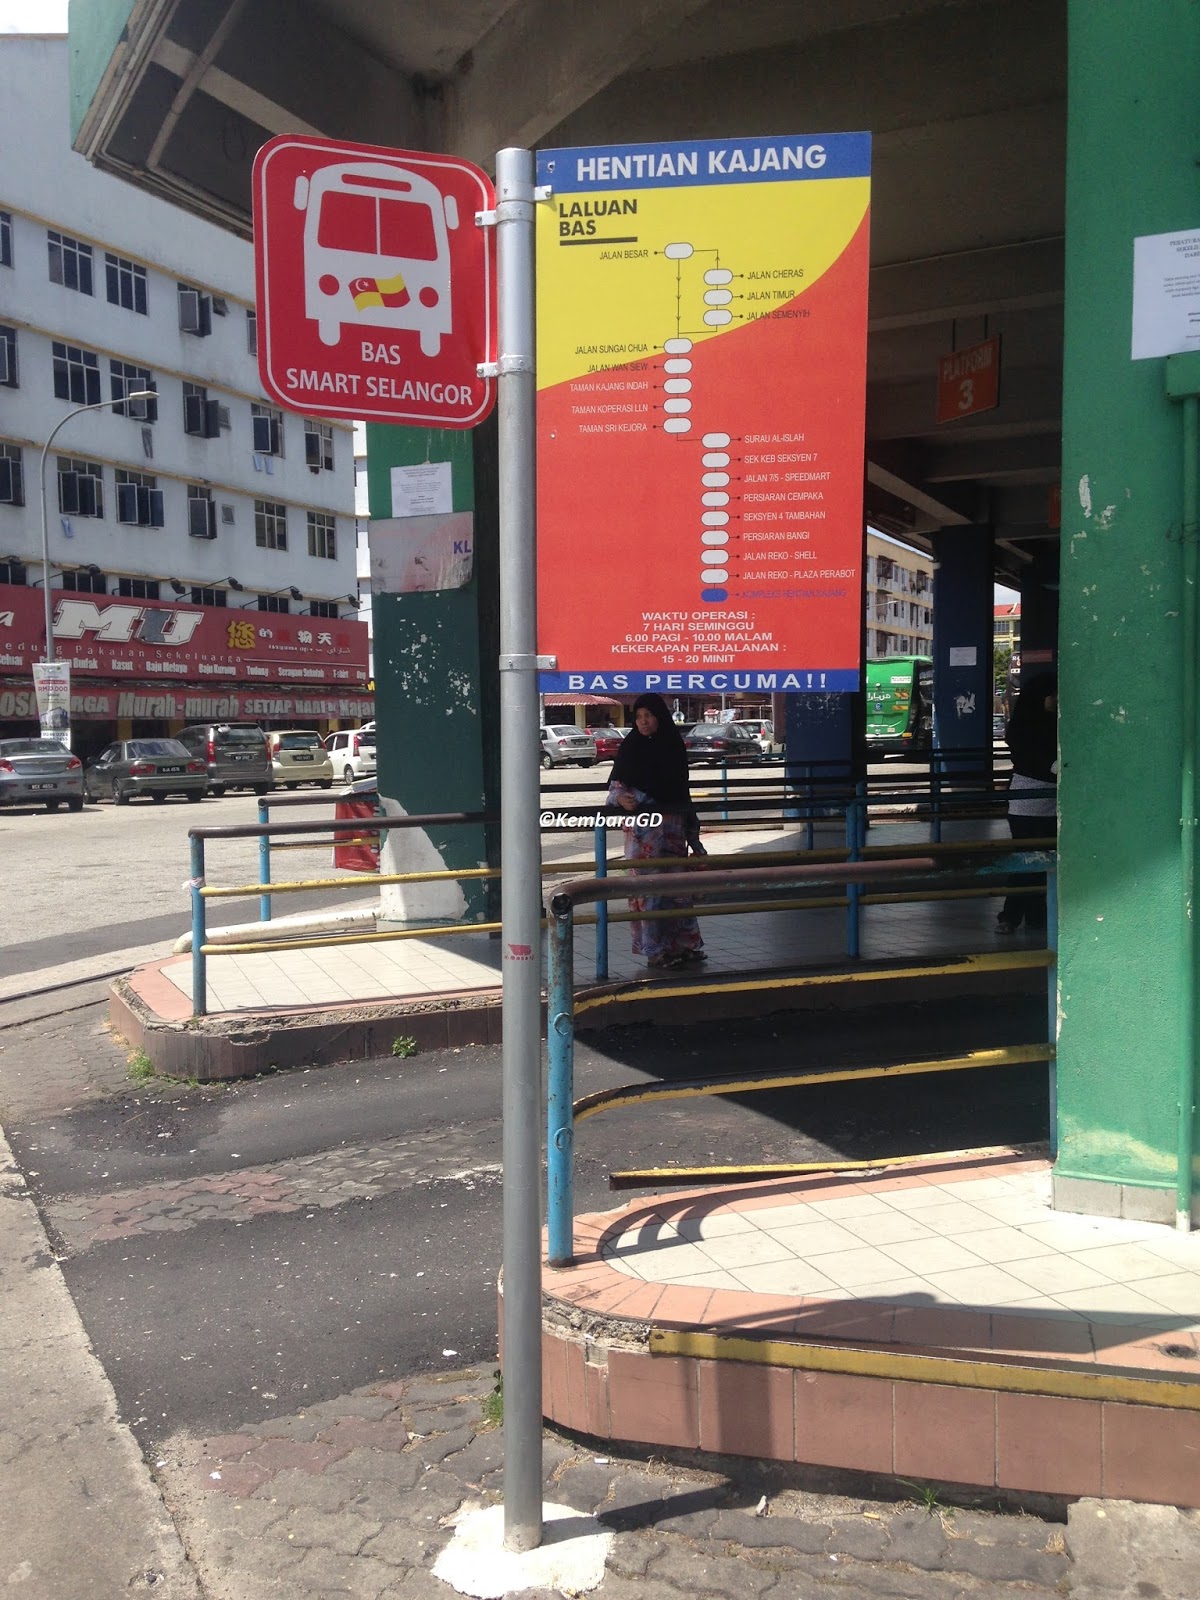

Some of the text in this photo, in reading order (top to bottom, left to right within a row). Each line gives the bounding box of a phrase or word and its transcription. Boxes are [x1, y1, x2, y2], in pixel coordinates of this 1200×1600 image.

[577, 144, 827, 181] HENTIAN KAJANG
[559, 199, 638, 219] LALUAN
[559, 220, 597, 237] BAS
[599, 249, 649, 260] JALAN BESAR
[747, 269, 804, 280] JALAN CHERAS
[746, 289, 796, 300] JALAN TIMUR
[746, 309, 810, 320] JALAN SEMENYIH
[361, 341, 401, 365] BAS
[575, 343, 648, 355] JALAN SUNGAI CHUA
[587, 362, 648, 373] JALAN WAN SIEW
[943, 346, 992, 383] PLATFORM
[286, 368, 473, 406] SMART SELANGOR
[570, 381, 649, 392] TAMAN KAJANG INDAH
[958, 379, 974, 410] 3
[571, 403, 648, 414] TAMAN KOPERASI LLN
[579, 423, 648, 433] TAMAN SRI KEJORA
[744, 433, 805, 443] SURAU AL-ISLAH
[744, 453, 818, 463] SEK KEB SEKSYEN 7
[744, 474, 767, 483] JALAN
[768, 473, 779, 482] 7/5
[785, 472, 831, 482] SPEEDMART
[743, 492, 824, 502] PERSIARAN CEMPAKA
[743, 511, 826, 521] SEKSYEN 4 TAMBAHAN
[743, 531, 810, 541] PERSIARAN BANGI
[453, 540, 472, 554] KL
[743, 552, 767, 561] JALAN
[768, 551, 788, 561] REKO
[795, 551, 817, 560] SHELL
[743, 571, 767, 580] JALAN
[768, 571, 788, 580] REKO
[794, 570, 819, 579] PLAZA
[820, 569, 856, 578] PERABOT
[642, 611, 688, 621] WAKTU
[691, 611, 748, 621] OPERASI
[643, 622, 755, 632] 7 HARI SEMINGGU
[625, 633, 648, 643] 6.00
[652, 633, 681, 642] PAGI
[692, 633, 721, 642] 10.00
[724, 632, 773, 641] MALAM
[611, 644, 690, 653] KEKERAPAN
[693, 643, 778, 653] PERJALANAN
[75, 645, 145, 658] Pakaian
[155, 650, 241, 663] Sekeluarga
[661, 655, 675, 664] 15
[685, 655, 700, 664] 20
[702, 654, 736, 663] MINIT
[0, 653, 23, 666] eluar
[73, 657, 98, 669] Budak
[111, 659, 134, 671] Kasut
[146, 661, 162, 673] Baju
[163, 661, 188, 674] Melayu
[198, 663, 213, 675] Baju
[568, 673, 827, 690] BAS PERCUMA!!
[70, 695, 109, 713] RGA
[117, 692, 240, 718] Murah-murah
[245, 699, 292, 714] SETIAP
[295, 700, 326, 714] HARI
